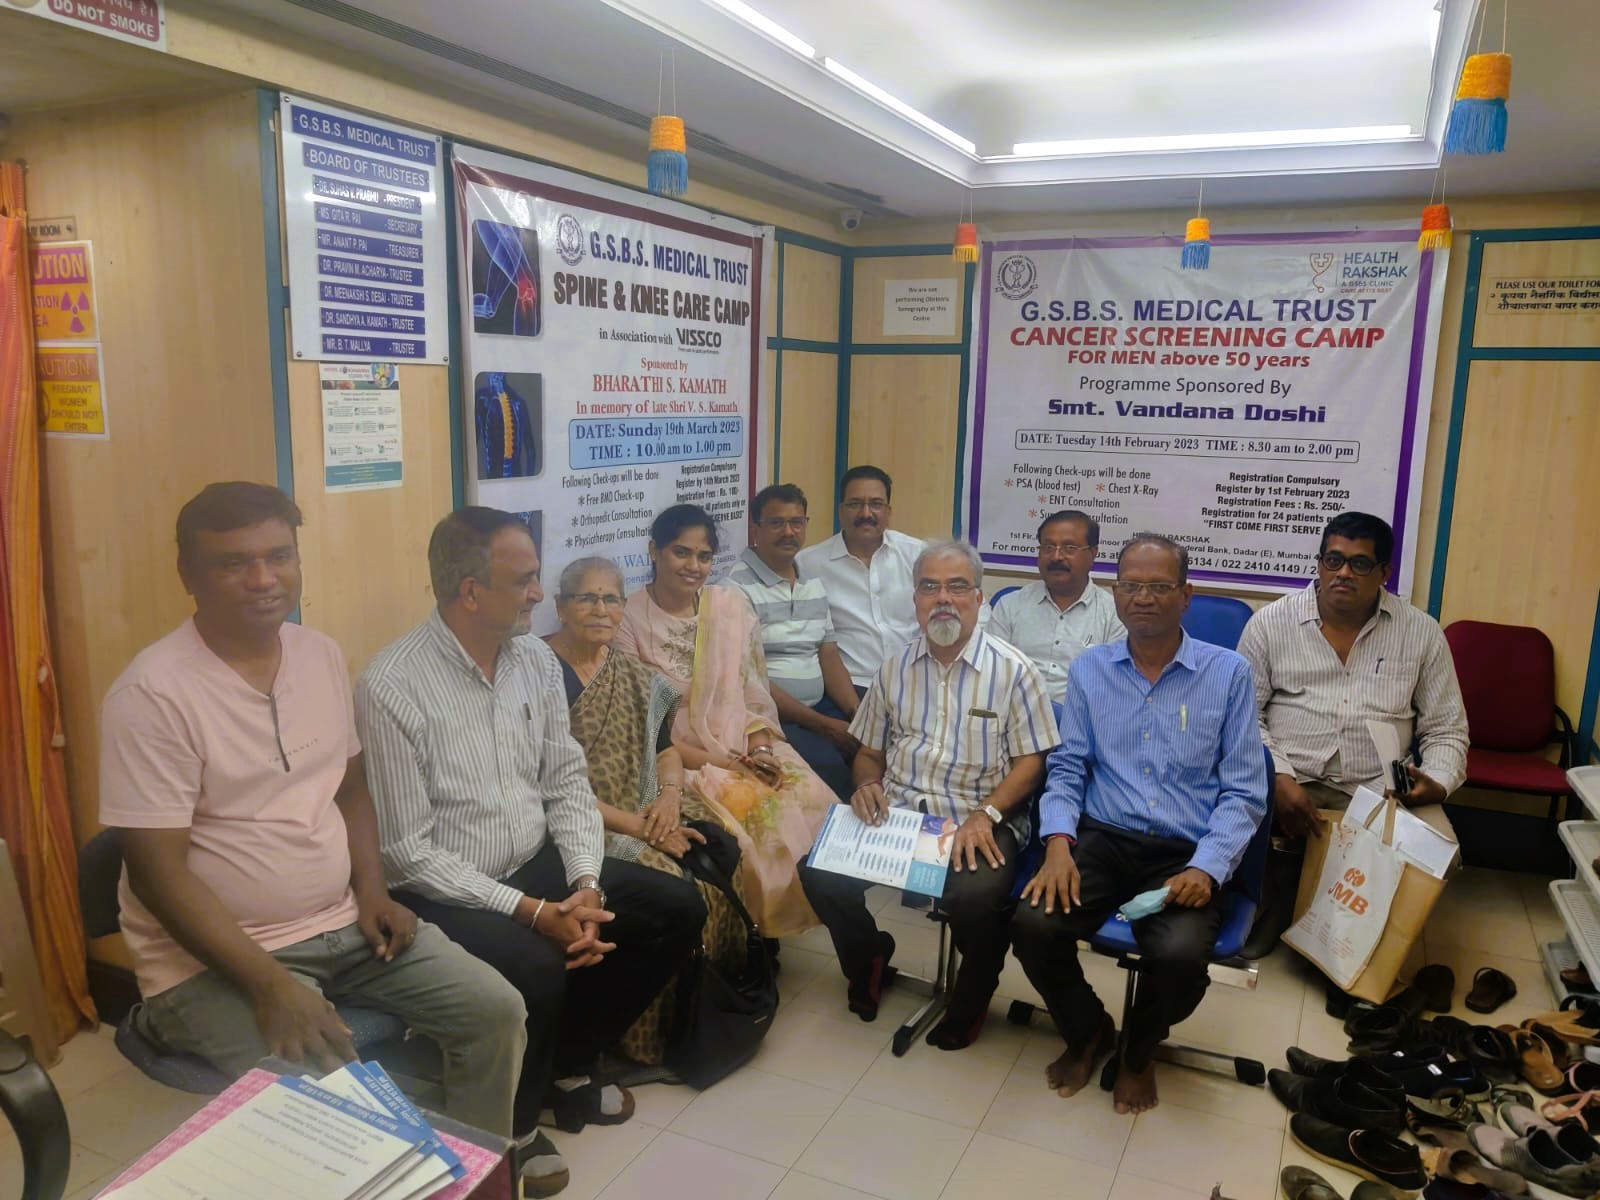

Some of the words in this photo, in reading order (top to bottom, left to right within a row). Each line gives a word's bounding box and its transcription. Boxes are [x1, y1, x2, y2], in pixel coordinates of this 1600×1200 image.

[54, 0, 73, 14] DO
[77, 5, 104, 22] NOT
[110, 13, 154, 37] SMOKE
[300, 114, 344, 137] G.S.B.S.
[347, 126, 395, 150] MEDICAL
[397, 139, 430, 158] TRUST
[310, 150, 350, 170] BOARD
[353, 159, 369, 174] OF
[371, 163, 425, 187] TRUSTEES
[355, 188, 379, 203] PRABHU
[331, 209, 345, 221] GITA
[352, 212, 361, 224] PAI
[333, 235, 352, 249] ANANT
[358, 239, 367, 251] PAI
[590, 230, 649, 268] G.S.B.S.
[653, 243, 710, 280] MEDICAL
[713, 257, 749, 286] TRUST
[1344, 251, 1399, 265] HEALTH
[333, 260, 354, 275] PRAVIN
[1342, 265, 1408, 279] RAKSHAK
[1496, 280, 1520, 289] PLEASE
[1523, 280, 1536, 288] USE
[1538, 280, 1555, 289] OUR
[1559, 280, 1584, 289] TOILET
[334, 286, 365, 301] MEENAKSHI
[371, 291, 386, 303] DESAI
[554, 271, 608, 310] SPINE
[613, 280, 626, 311] &
[630, 282, 669, 317] KNEE
[673, 290, 710, 322] CARE
[714, 296, 750, 327] CAMP
[1021, 300, 1124, 322] G.S.B.S.
[1133, 299, 1263, 322] MEDICAL
[1273, 299, 1377, 322] TRUST
[336, 312, 360, 326] SANDHYA
[366, 316, 388, 329] KAMATH
[350, 339, 371, 352] MALLYA
[599, 328, 608, 340] in
[610, 329, 658, 344] Association
[658, 332, 673, 345] with
[676, 327, 722, 348] VISSCO
[1010, 326, 1118, 347] CANCER
[1123, 326, 1287, 348] SCREENING
[1295, 327, 1385, 348] CAMP
[641, 357, 678, 371] Sponsored
[679, 360, 689, 373] by
[1067, 350, 1106, 364] FOR
[1111, 350, 1156, 365] MEN
[1160, 352, 1220, 366] above
[1225, 352, 1250, 367] 50
[1254, 354, 1310, 371] years
[52, 384, 92, 393] PREGNANT
[592, 374, 663, 393] BHARATHI
[666, 376, 675, 393] S.
[679, 377, 727, 395] KAMATH
[1080, 376, 1171, 395] Programme
[1176, 378, 1265, 395] Sponsored
[1271, 380, 1292, 398] By
[576, 401, 587, 415] In
[591, 403, 632, 417] memory
[635, 400, 650, 414] of
[652, 401, 668, 414] late
[669, 401, 686, 413] Shri
[688, 401, 696, 413] V.
[698, 402, 707, 413] S.
[708, 401, 738, 413] Kamath
[1048, 399, 1105, 416] Smt.
[1116, 400, 1234, 420] Vandana
[1244, 404, 1326, 423] Doshi
[64, 422, 88, 433] ENTER
[576, 423, 615, 440] DATE:
[618, 422, 663, 439] Sunday
[665, 421, 684, 436] 19th
[687, 420, 717, 435] March
[720, 420, 741, 434] 2023
[589, 444, 623, 461] TIME
[636, 442, 666, 458] 10.00
[667, 445, 681, 455] am
[683, 442, 692, 455] to
[695, 440, 714, 453] 1.00
[717, 442, 731, 456] pm
[1020, 433, 1052, 444] DATE:
[1056, 434, 1096, 448] Tuesday
[1100, 435, 1121, 447] 14th
[1125, 437, 1171, 451] February
[1174, 438, 1199, 450] 2023
[1206, 439, 1238, 451] TIME
[1247, 441, 1271, 453] 8.30
[1273, 445, 1291, 453] am
[1294, 443, 1305, 454] to
[1308, 443, 1332, 455] 2.00
[1335, 447, 1354, 458] pm
[681, 464, 710, 475] Registration
[711, 462, 737, 473] Compulsory
[1013, 463, 1052, 477] Following
[1054, 464, 1096, 479] Check-ups
[1098, 466, 1114, 477] will
[1116, 467, 1127, 479] be
[1128, 467, 1151, 480] done
[562, 474, 591, 489] Following
[592, 472, 620, 486] Check-ups
[621, 469, 633, 482] will
[634, 469, 643, 480] be
[645, 468, 660, 480] done
[1229, 472, 1284, 484] Registration
[1287, 474, 1340, 487] Compulsory
[1016, 479, 1032, 489] PSA
[1034, 479, 1061, 491] (blood
[1062, 480, 1081, 493] test)
[1108, 482, 1131, 494] Chest
[1133, 484, 1159, 498] X-Ray
[1215, 483, 1252, 495] Register
[1254, 484, 1265, 496] by
[1268, 486, 1282, 496] 1st
[1284, 487, 1325, 500] February
[1327, 489, 1350, 500] 2023
[586, 493, 599, 506] Free
[614, 489, 644, 502] Check-up
[1049, 495, 1066, 505] ENT
[1068, 496, 1120, 508] Consultation
[1217, 496, 1272, 508] Registration
[1274, 499, 1296, 509] Fees
[1304, 501, 1319, 511] Rs.
[1322, 502, 1345, 512] 250/-
[580, 511, 610, 527] Orthopedic
[611, 507, 653, 522] Consultation
[1201, 507, 1255, 519] Registration
[1258, 509, 1270, 520] for
[1273, 511, 1284, 521] 24
[1286, 512, 1325, 523] patients
[1235, 521, 1262, 531] COME
[1264, 523, 1290, 533] FIRST
[1291, 525, 1321, 535] SERVE
[574, 531, 615, 548] Physiotherapy
[992, 541, 1008, 551] For
[1011, 545, 1036, 553] more
[1207, 546, 1231, 555] Bank,
[1233, 547, 1258, 557] Dadar
[1277, 551, 1312, 561] Mumbai
[1221, 559, 1241, 569] 022
[1244, 561, 1270, 571] 2410
[1273, 563, 1300, 574] 4149
